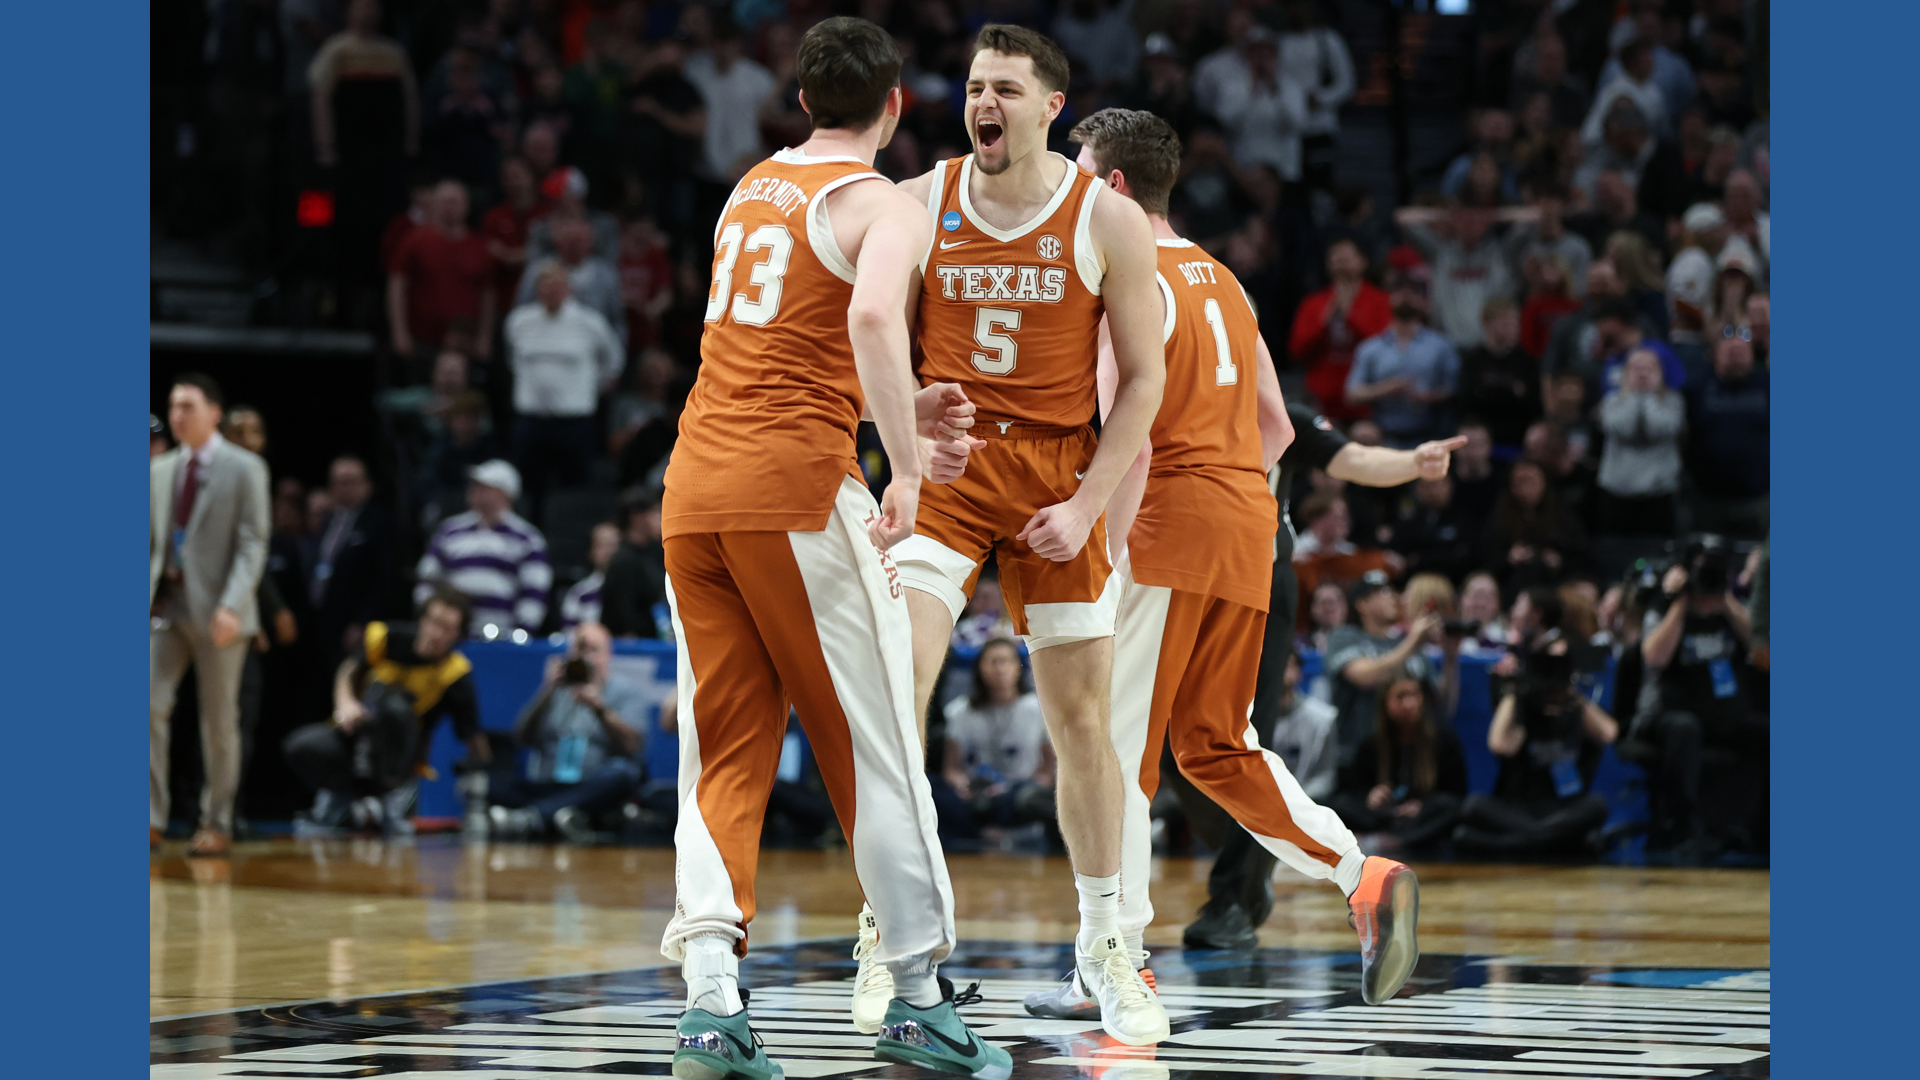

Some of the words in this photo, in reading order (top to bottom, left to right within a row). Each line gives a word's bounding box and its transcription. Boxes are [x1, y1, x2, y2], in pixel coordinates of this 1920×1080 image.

[704, 222, 794, 327] 33
[936, 264, 1067, 303] TEXAS
[1037, 238, 1061, 259] SEC
[1177, 261, 1217, 286] BOTT
[971, 306, 1023, 377] 5
[1204, 298, 1237, 386] 1
[863, 509, 904, 599] TXAS
